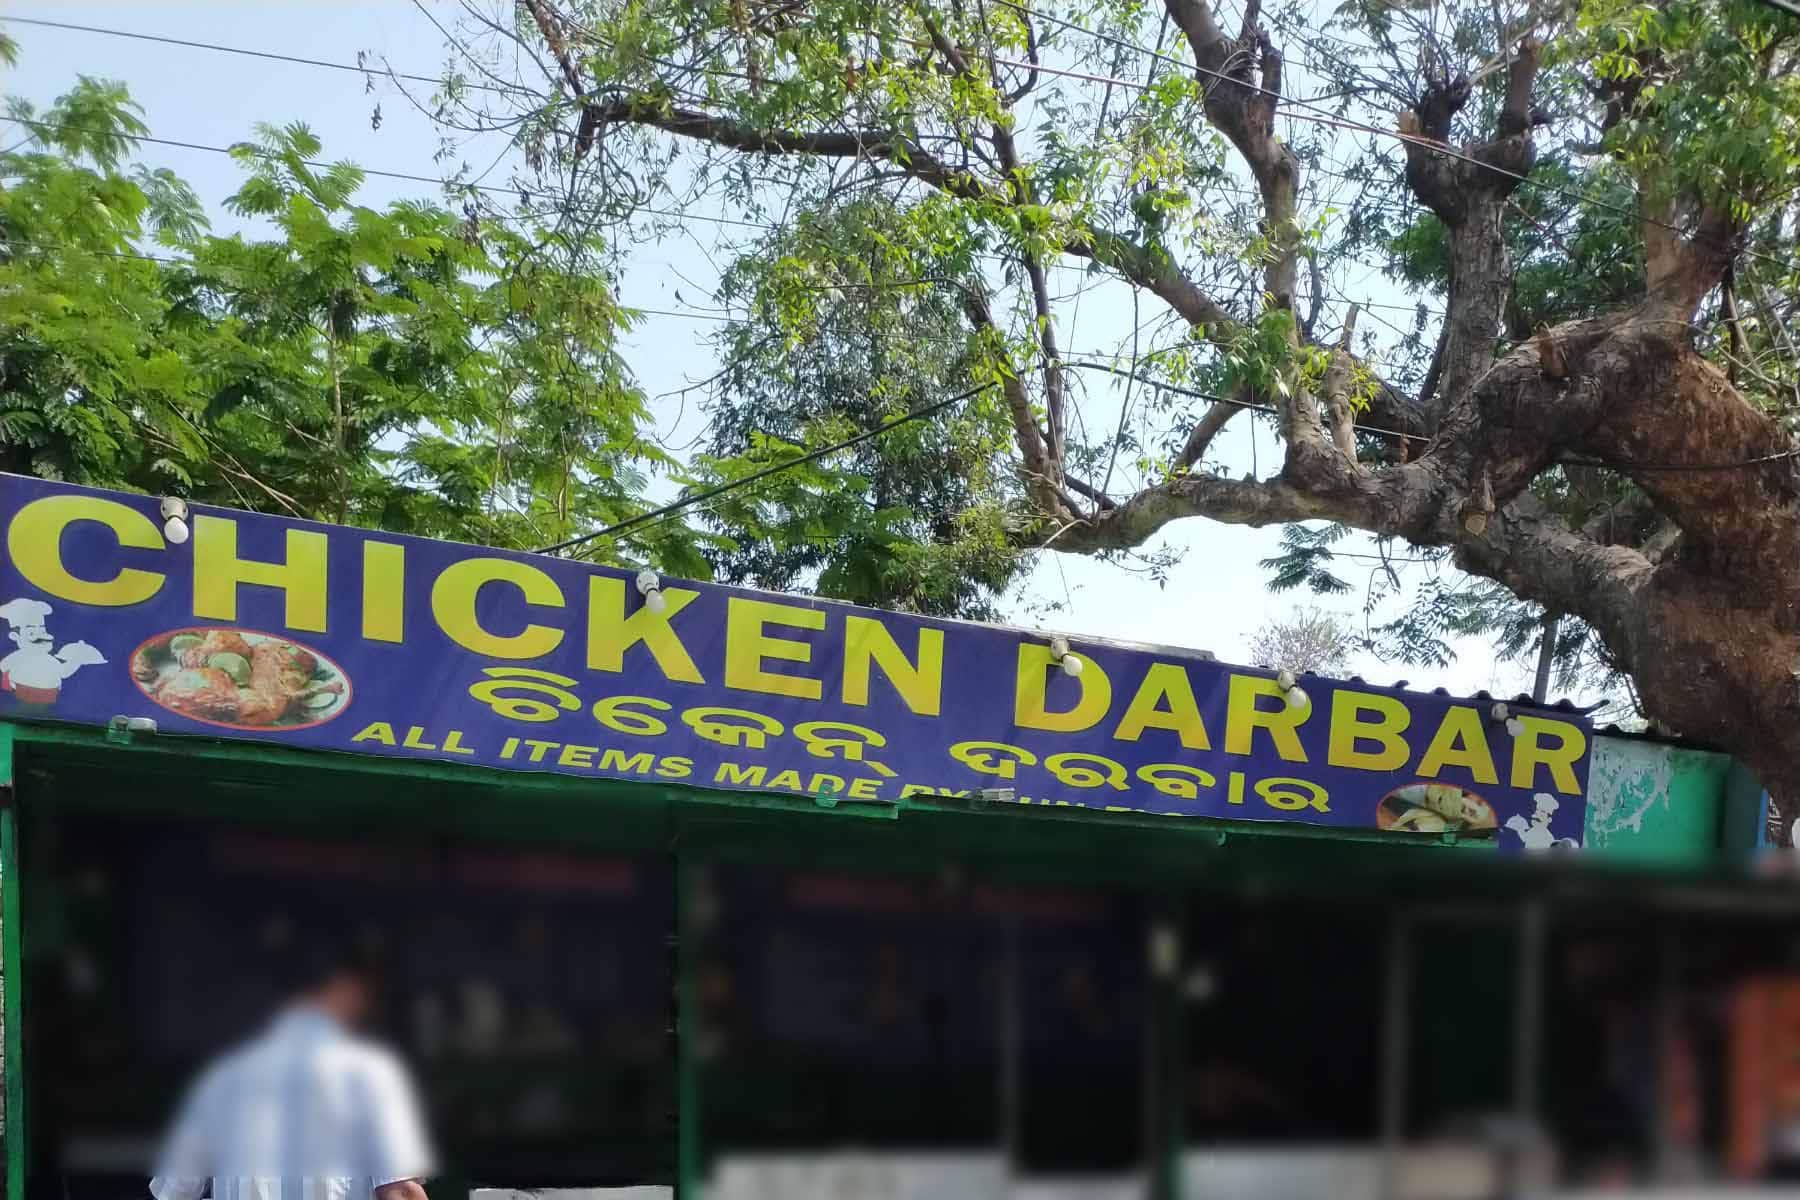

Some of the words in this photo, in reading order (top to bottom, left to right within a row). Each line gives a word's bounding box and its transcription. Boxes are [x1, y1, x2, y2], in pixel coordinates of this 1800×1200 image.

[8, 496, 943, 717] CHICKEN
[1014, 643, 1588, 796] DARBAR
[351, 722, 475, 756] ALL
[499, 737, 694, 778] ITEMS
[713, 762, 885, 800] MADE
[468, 666, 899, 777] ଚିକେନ୍
[949, 741, 1331, 813] ଦରବାର
